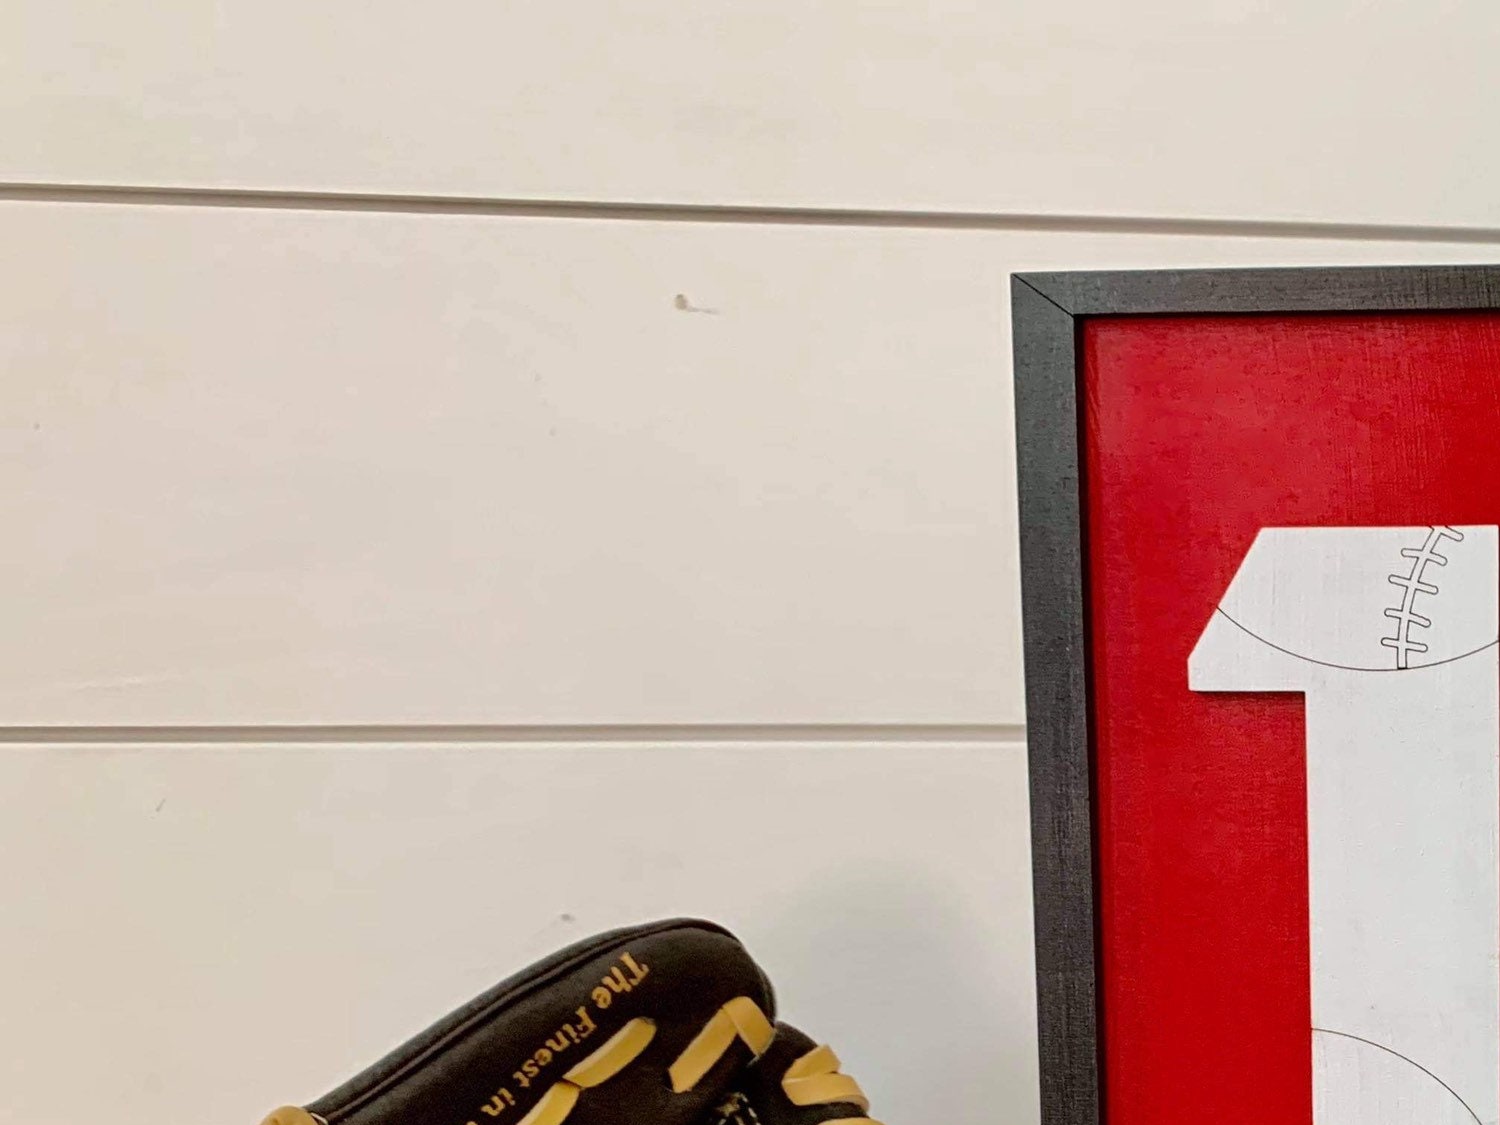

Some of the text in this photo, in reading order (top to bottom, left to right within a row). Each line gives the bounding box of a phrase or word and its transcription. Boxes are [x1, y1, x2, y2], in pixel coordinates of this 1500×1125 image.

[591, 952, 650, 1009] The
[513, 1005, 598, 1088] Finest
[481, 1087, 517, 1117] in
